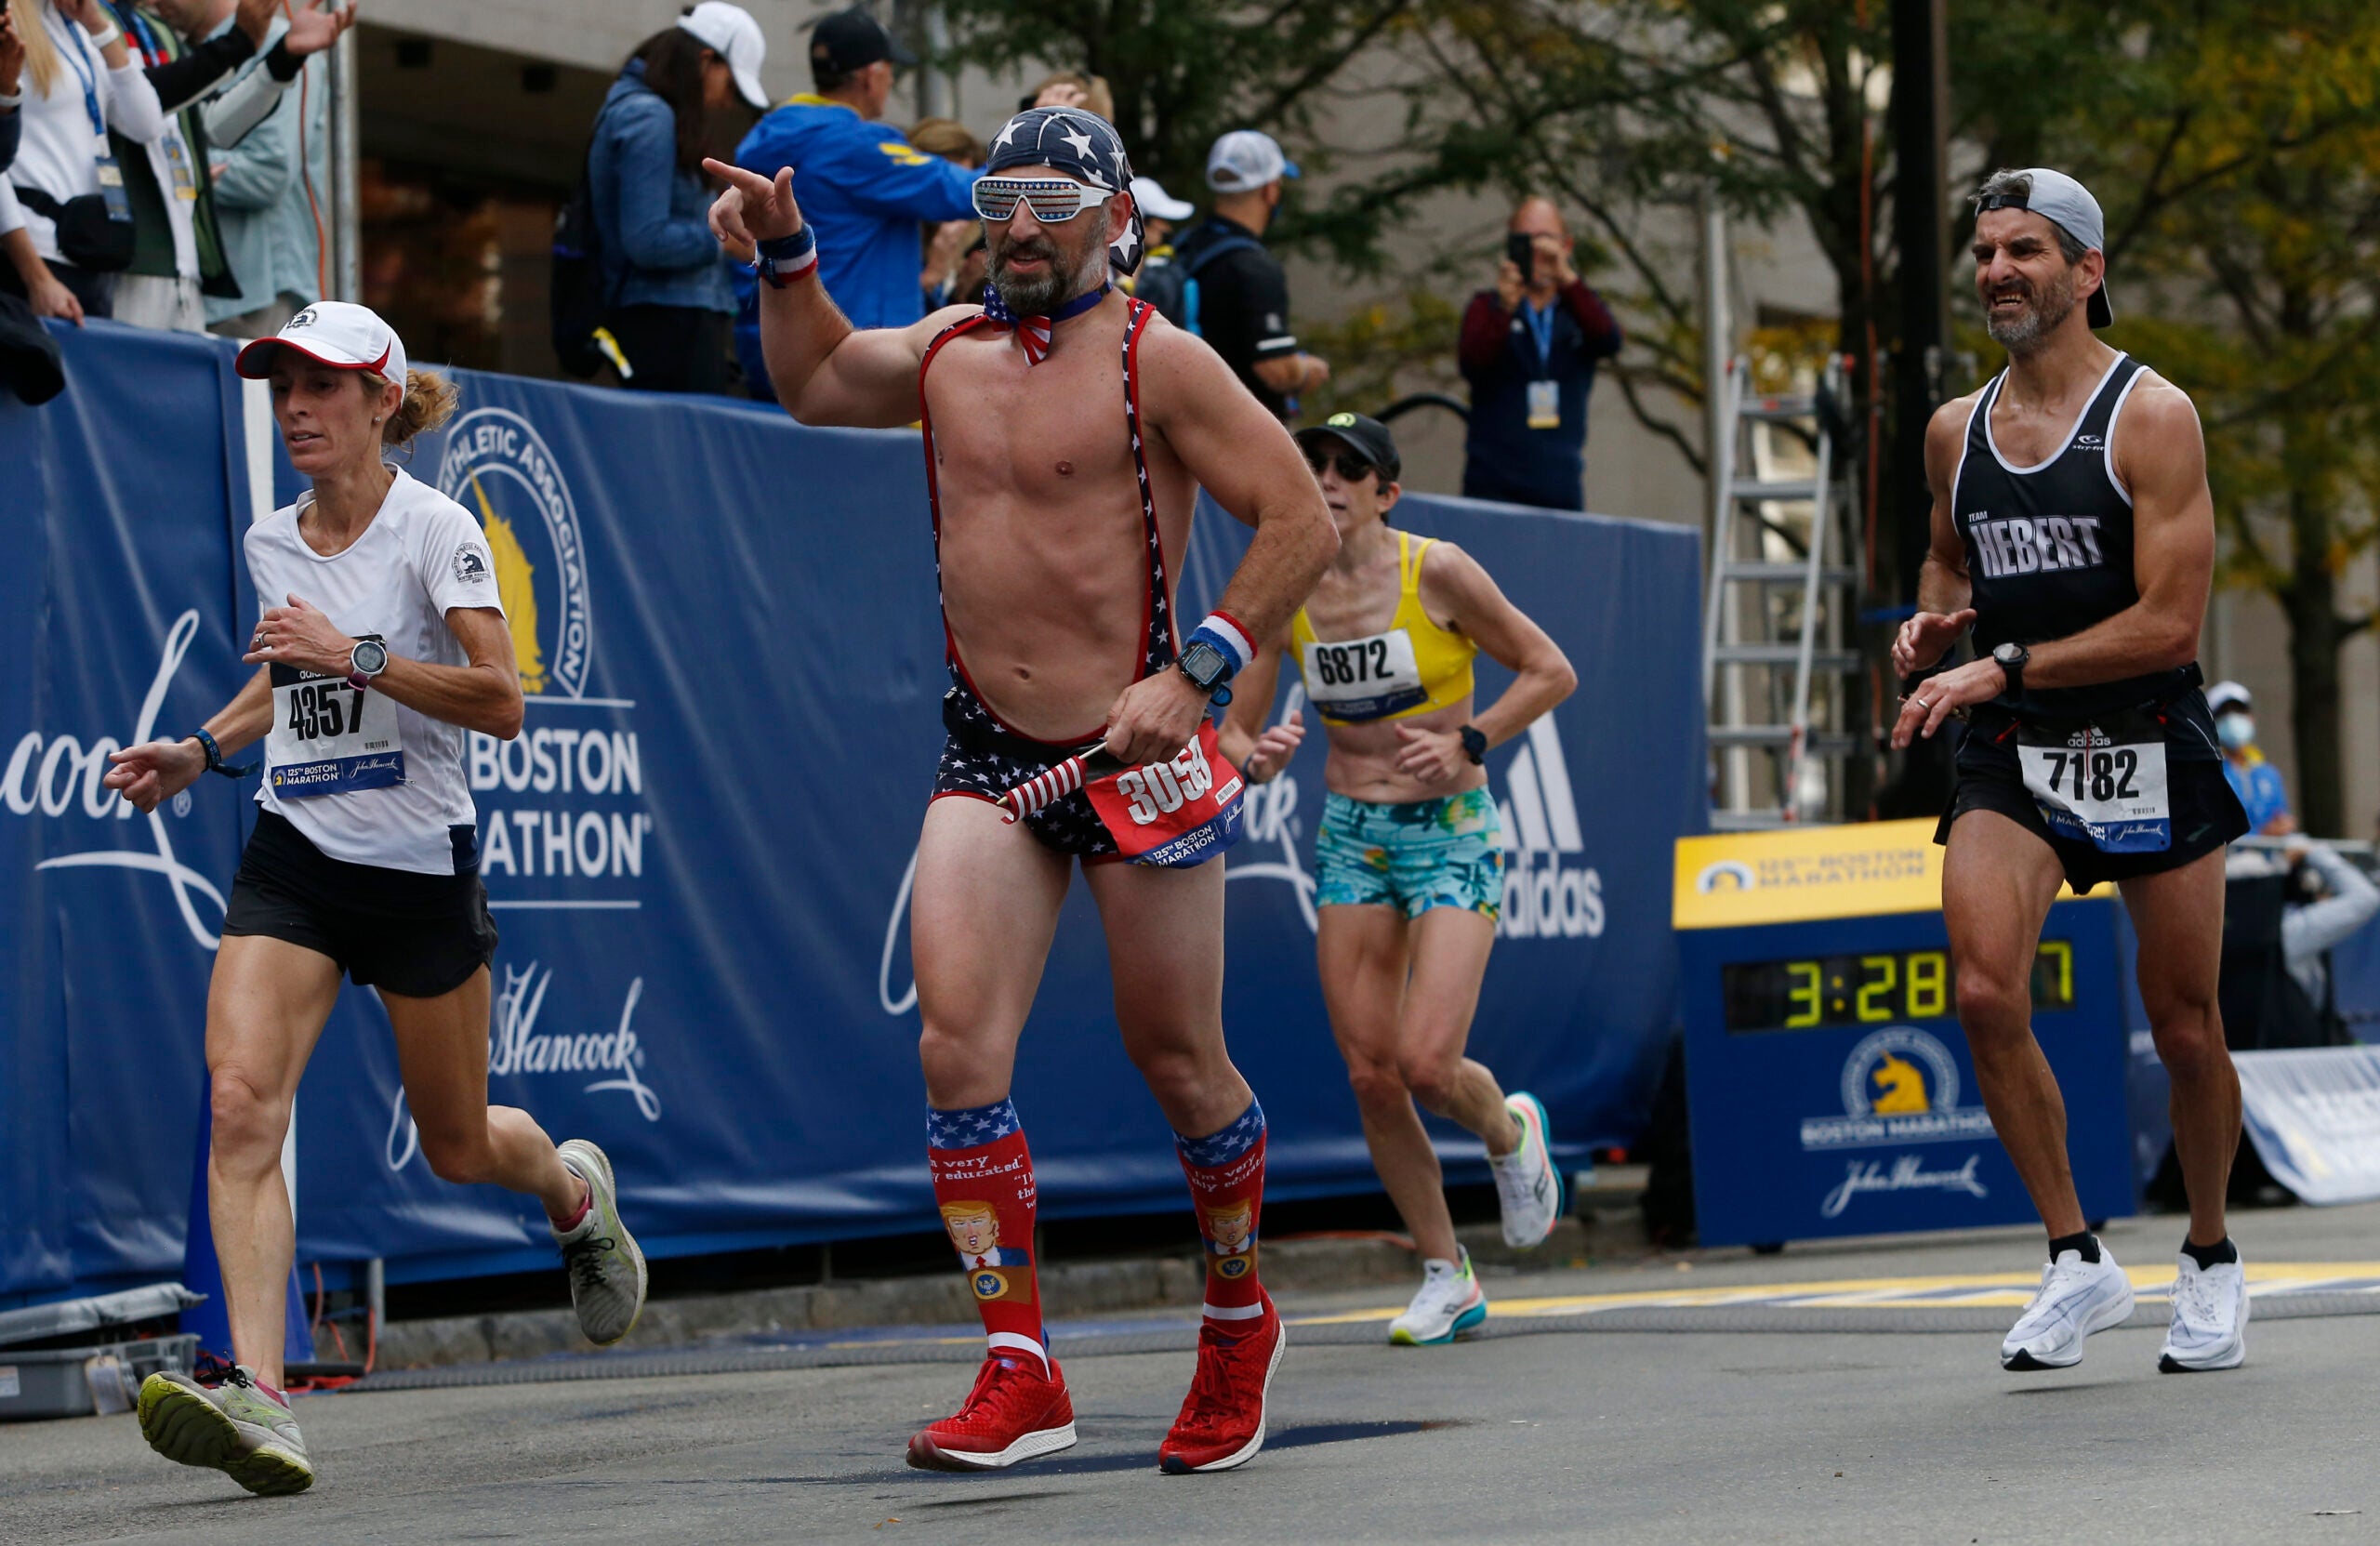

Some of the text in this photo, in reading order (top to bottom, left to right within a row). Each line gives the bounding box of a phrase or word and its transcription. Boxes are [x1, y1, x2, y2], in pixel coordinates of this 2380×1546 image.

[1968, 511, 1988, 522] TEAM
[443, 425, 585, 680] ATHLETIC ASSOCIATION
[1969, 515, 2103, 579] HEBERT
[1316, 639, 1395, 685] 6872
[288, 681, 365, 741] 4357
[2068, 736, 2111, 747] adidas
[304, 763, 337, 775] BOSTON
[349, 760, 368, 779] John
[469, 727, 641, 794] BOSTON
[2043, 749, 2139, 802] 7182
[0, 608, 228, 950] cock
[286, 773, 338, 786] MARATHON
[479, 810, 641, 878] ATHON
[1153, 826, 1212, 860] 125TH BOSTON
[1157, 833, 1215, 867] MARATHON
[2117, 825, 2135, 841] John
[1819, 848, 1924, 868] BOSTON
[1759, 865, 1925, 890] MARATHON
[1495, 851, 1606, 939] didas
[490, 959, 662, 1122] Hancock
[1801, 1119, 1884, 1145] BOSTON
[943, 1155, 989, 1169] very
[1223, 1153, 1256, 1177] very
